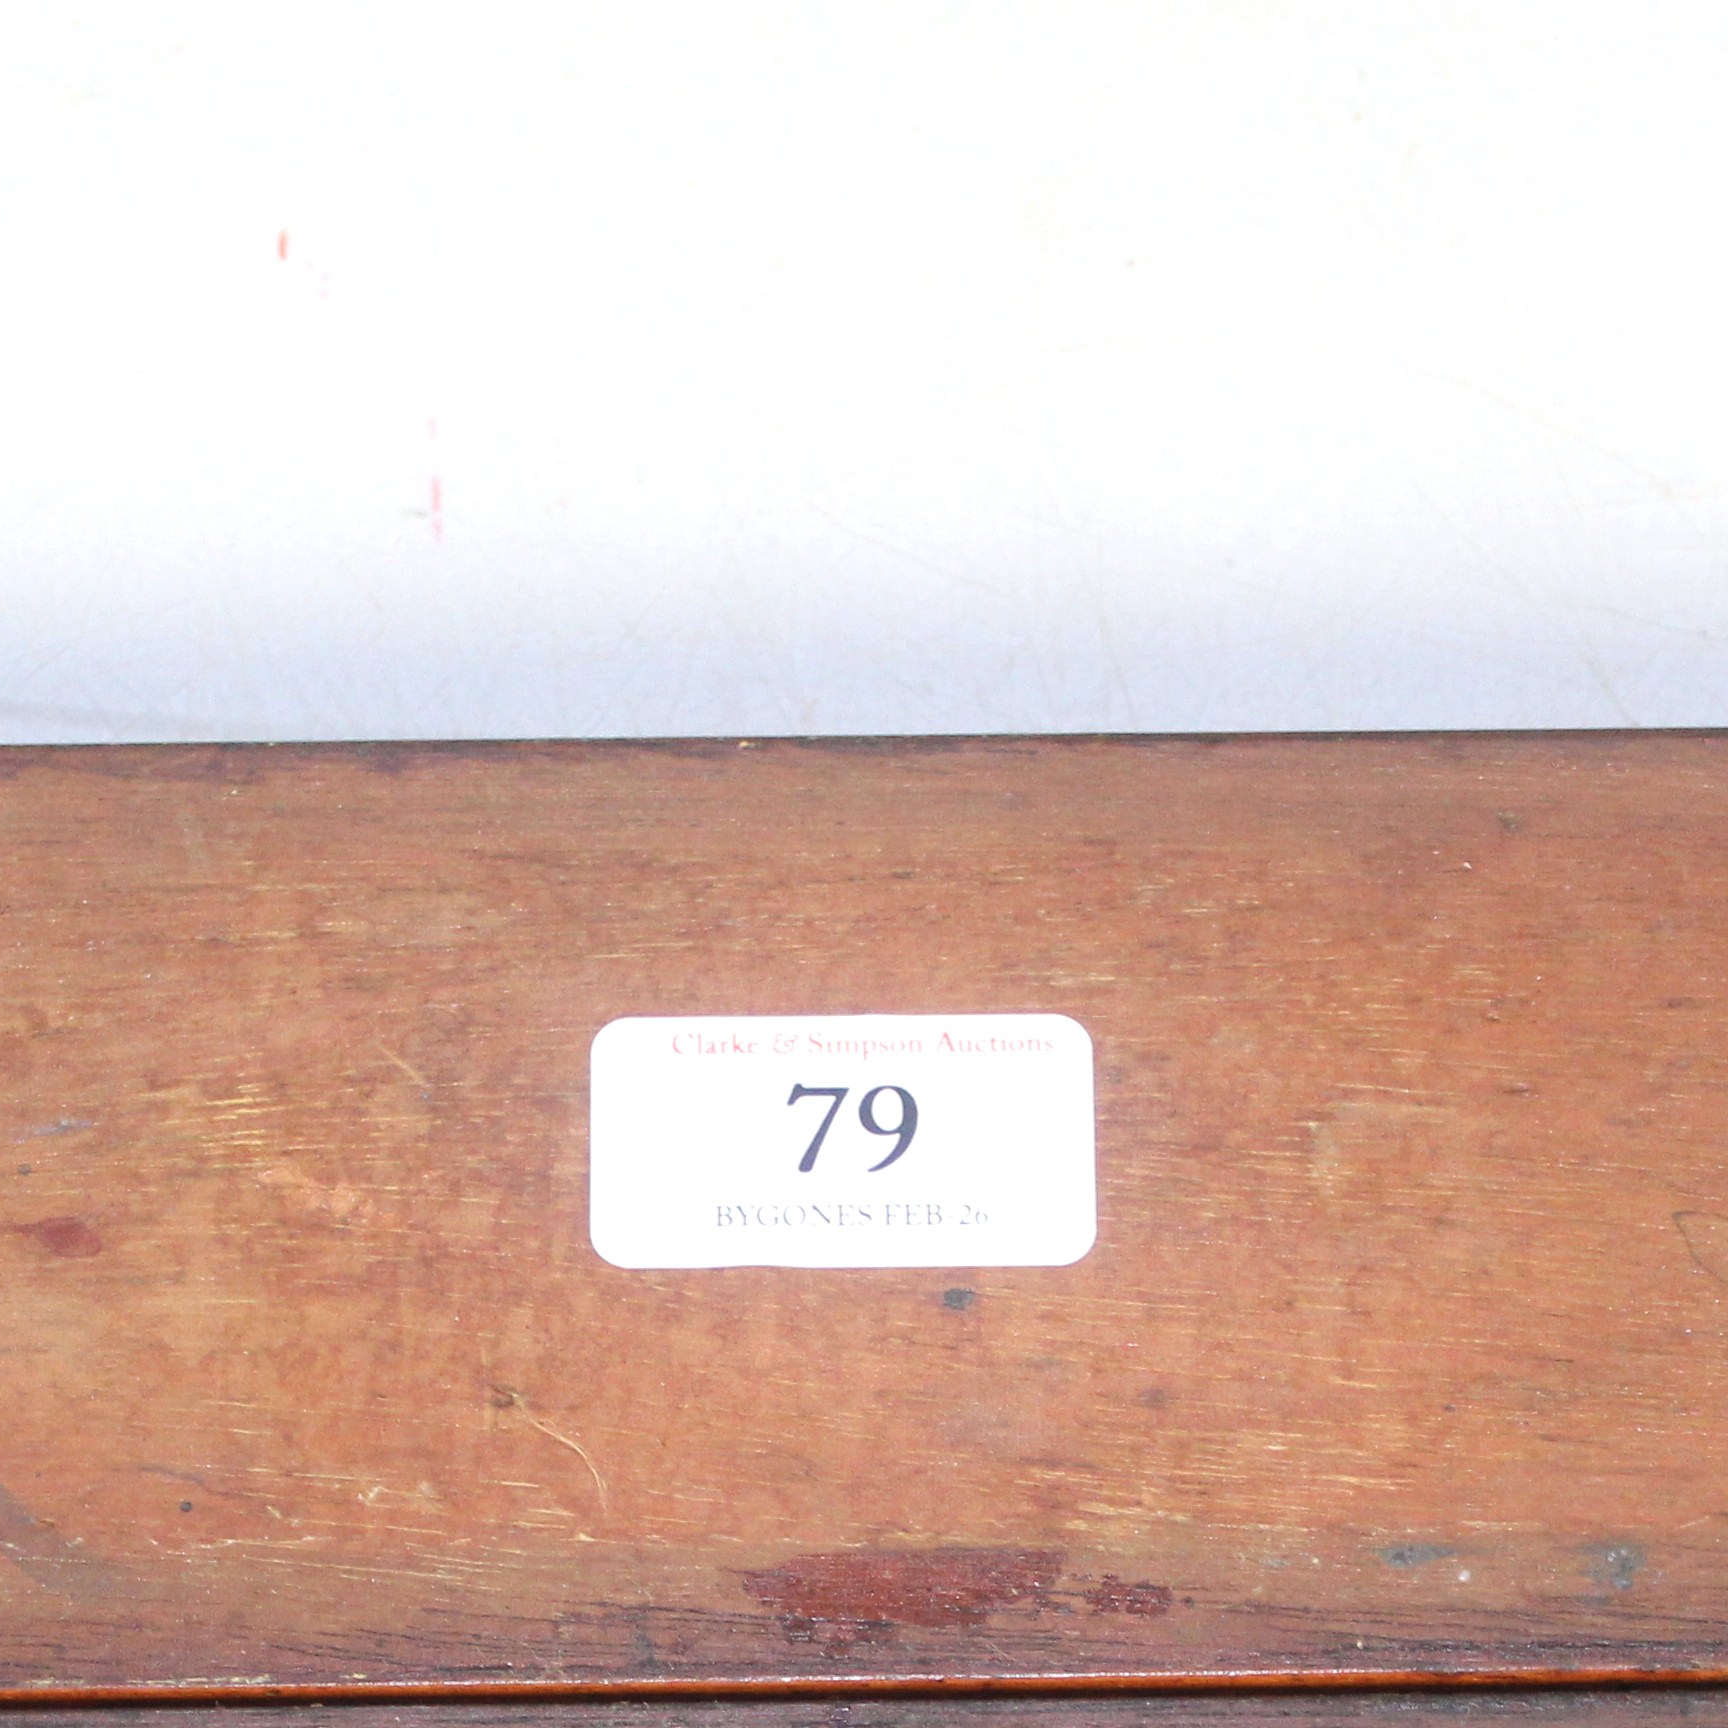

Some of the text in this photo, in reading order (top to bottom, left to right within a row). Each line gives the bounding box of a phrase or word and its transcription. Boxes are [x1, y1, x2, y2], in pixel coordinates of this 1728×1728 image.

[672, 1031, 1054, 1060] Clarke & Simpson Auctions
[786, 1082, 919, 1173] 79
[716, 1203, 989, 1228] BYGONES FEB-26
